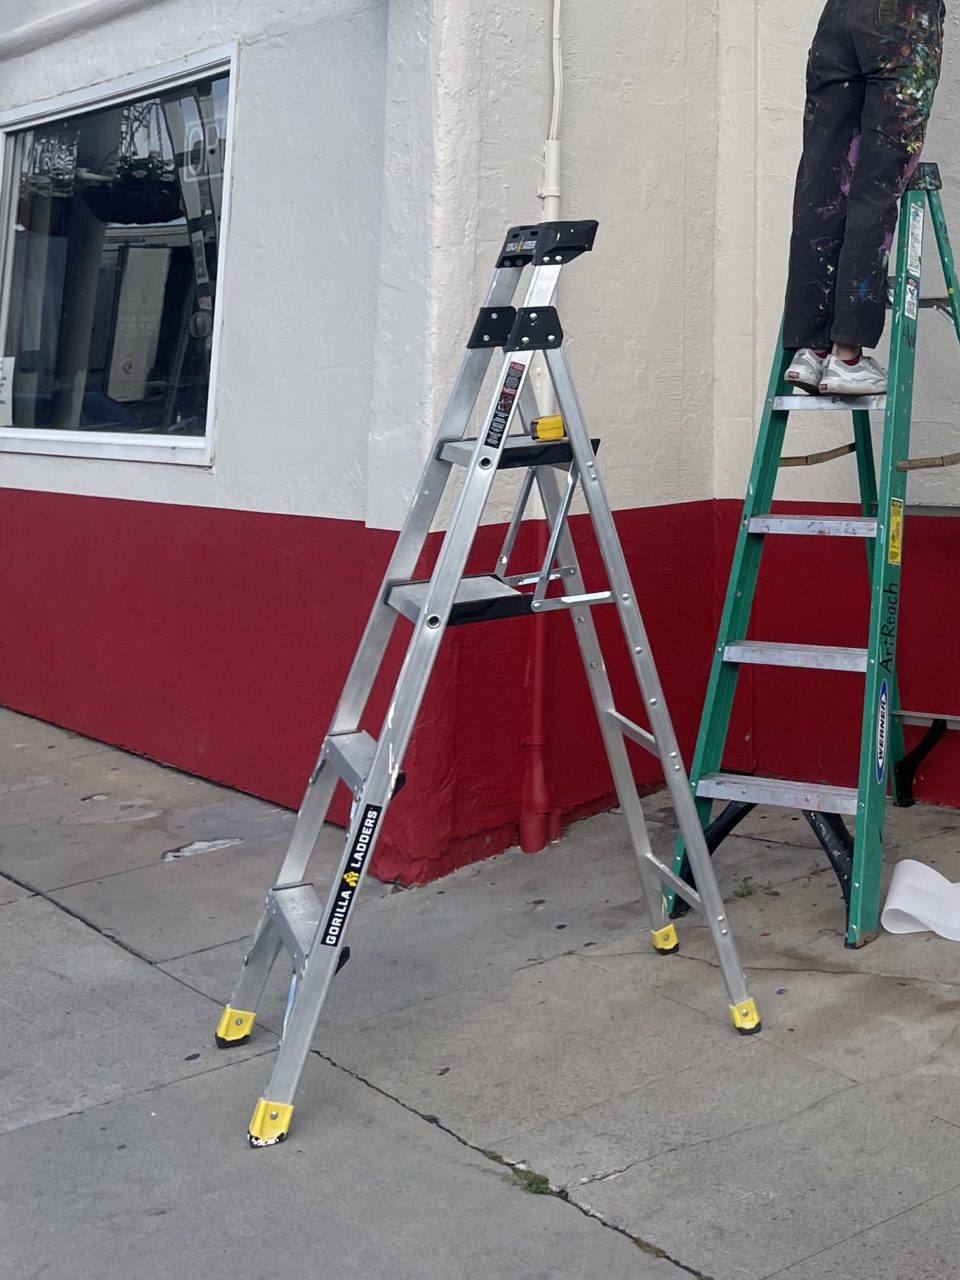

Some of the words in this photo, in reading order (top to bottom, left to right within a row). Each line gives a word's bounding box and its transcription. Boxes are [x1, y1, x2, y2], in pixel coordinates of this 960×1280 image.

[879, 582, 899, 674] ArtReach
[878, 700, 887, 761] WERNER
[325, 889, 353, 945] GORILLA
[350, 810, 378, 868] LADDERS
